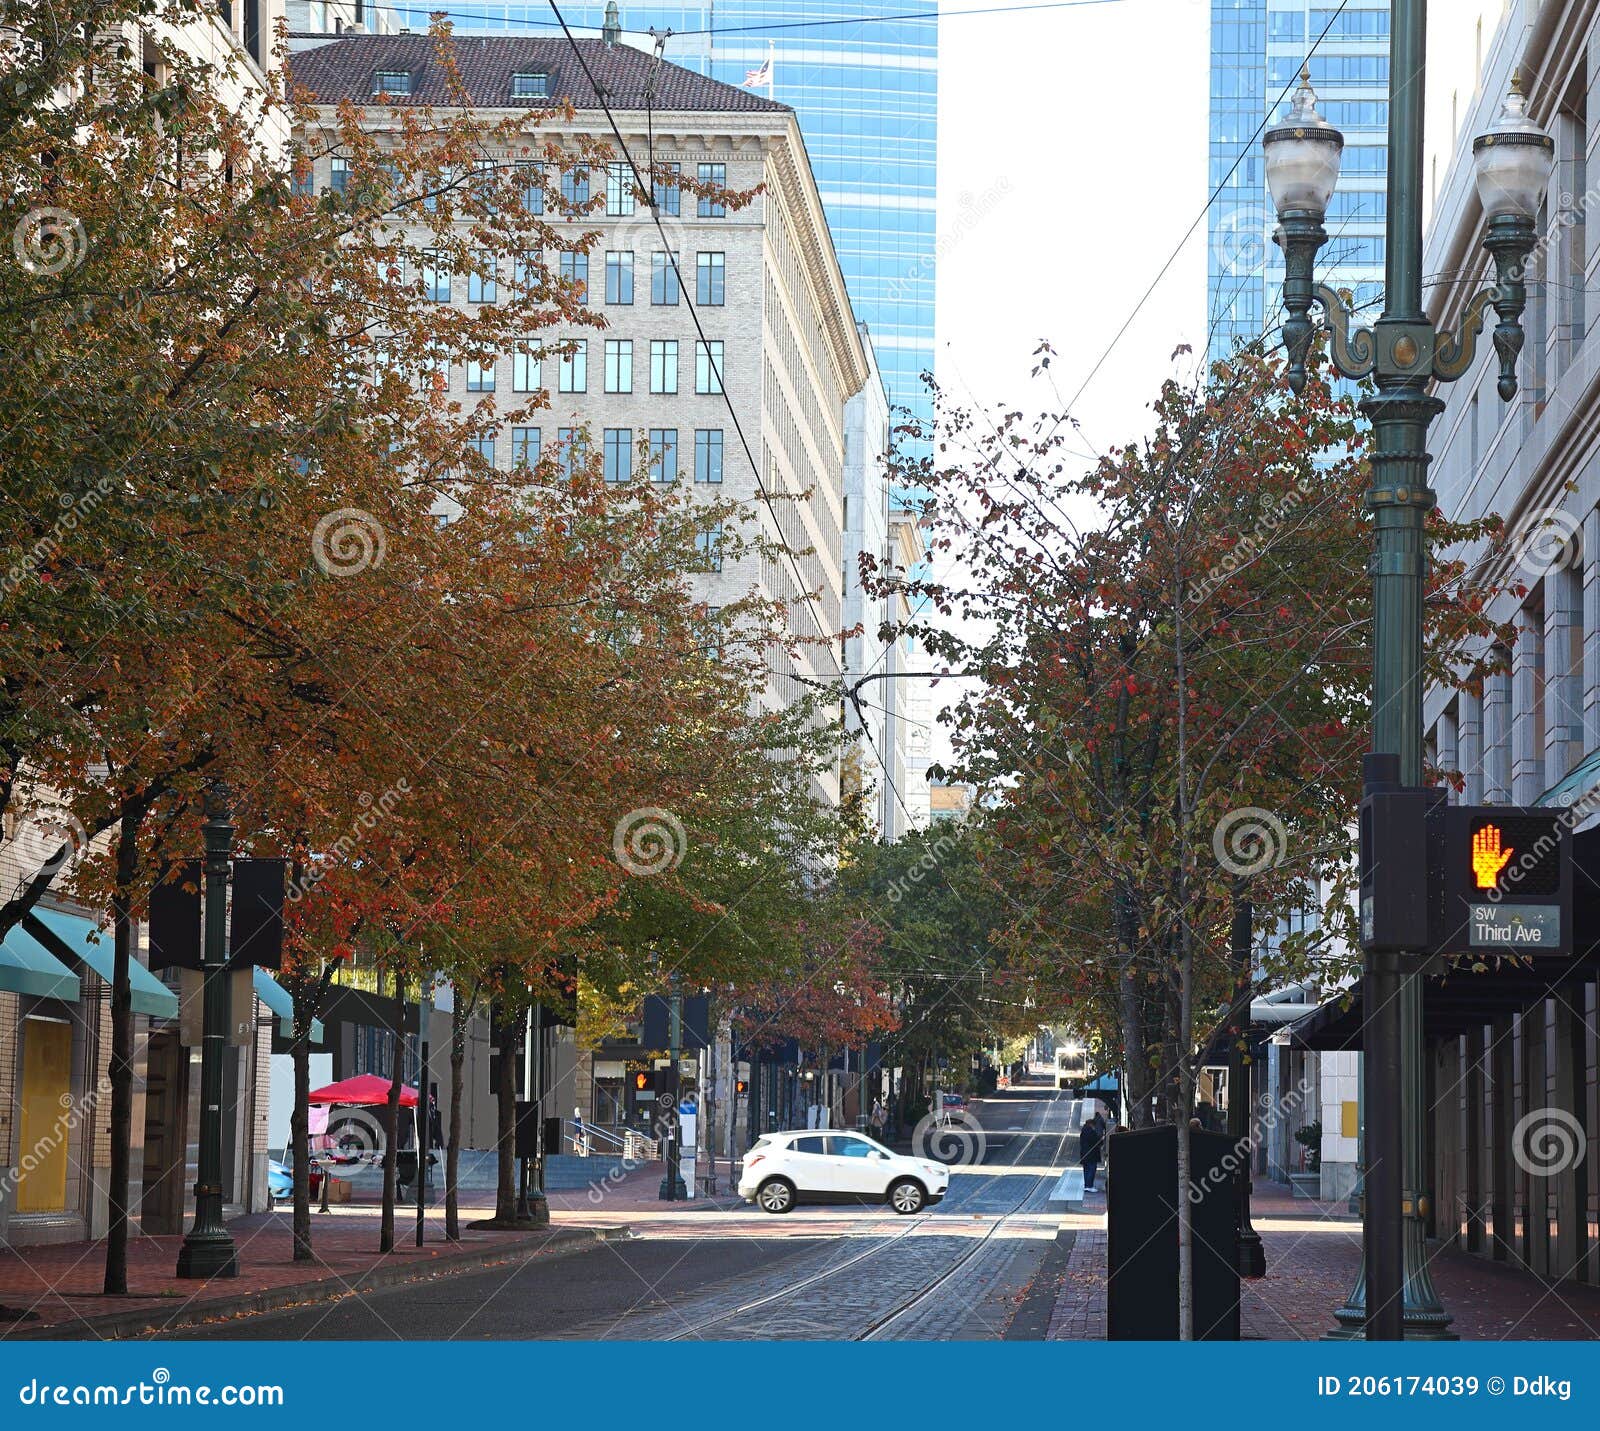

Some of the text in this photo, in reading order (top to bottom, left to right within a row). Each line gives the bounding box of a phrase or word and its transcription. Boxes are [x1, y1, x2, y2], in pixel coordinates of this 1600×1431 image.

[1475, 907, 1497, 920] SW
[1475, 924, 1542, 942] Third Ave
